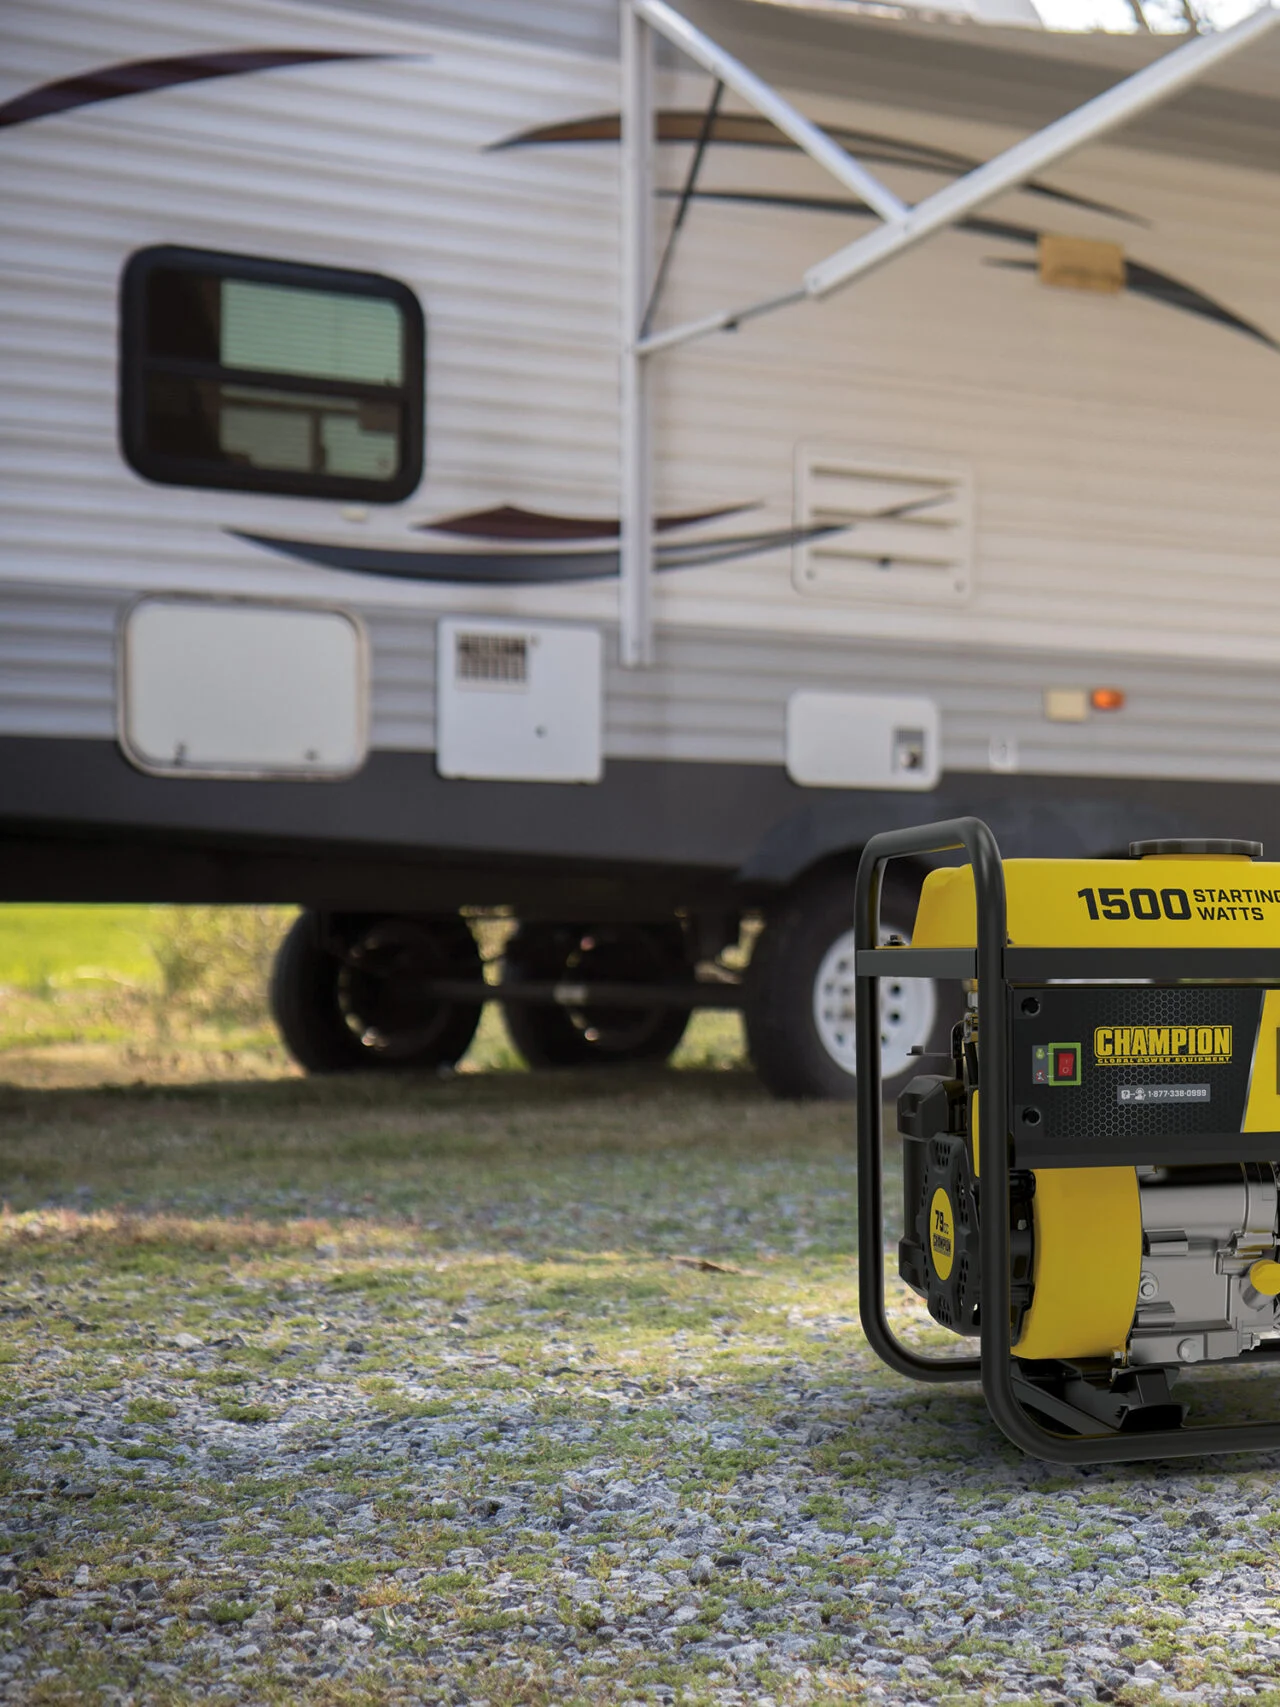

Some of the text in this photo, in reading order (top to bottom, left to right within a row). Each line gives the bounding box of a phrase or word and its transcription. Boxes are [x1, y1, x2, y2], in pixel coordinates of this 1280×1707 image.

[1077, 888, 1192, 920] 1500
[1197, 907, 1265, 921] WATTS
[1096, 1027, 1230, 1056] CHAMPION
